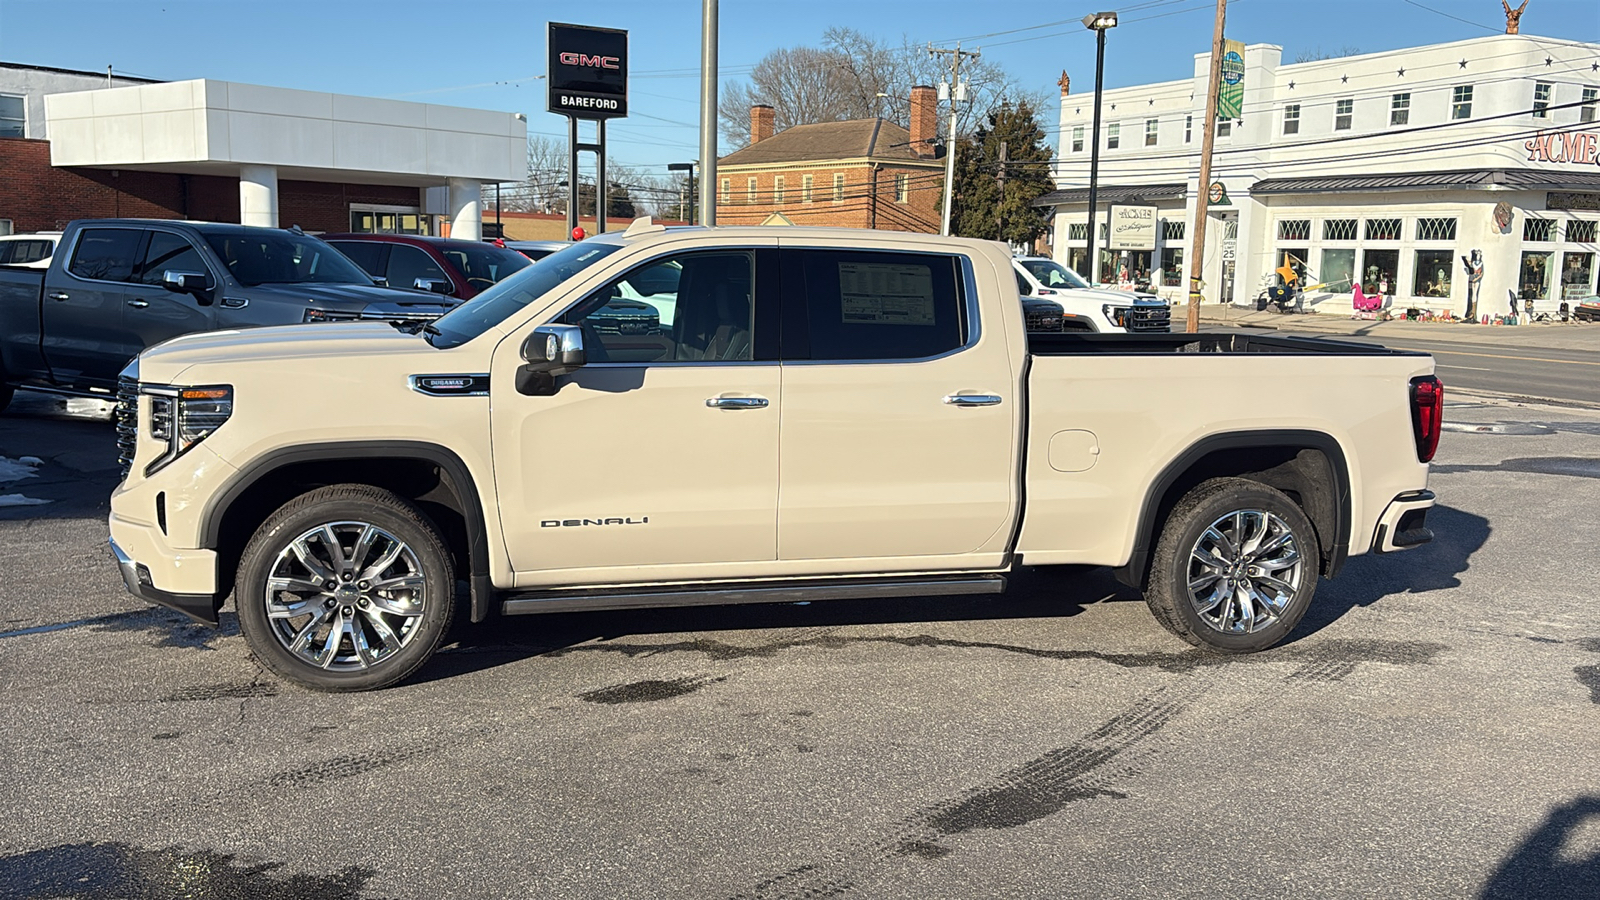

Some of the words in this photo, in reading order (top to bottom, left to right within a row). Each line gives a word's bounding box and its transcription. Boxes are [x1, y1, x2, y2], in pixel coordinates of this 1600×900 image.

[559, 51, 620, 70] GMC
[561, 95, 618, 110] BAREFORD
[1524, 130, 1598, 165] ACME
[1118, 208, 1152, 220] ACME
[1223, 250, 1235, 259] 25
[540, 516, 649, 528] DENALI
